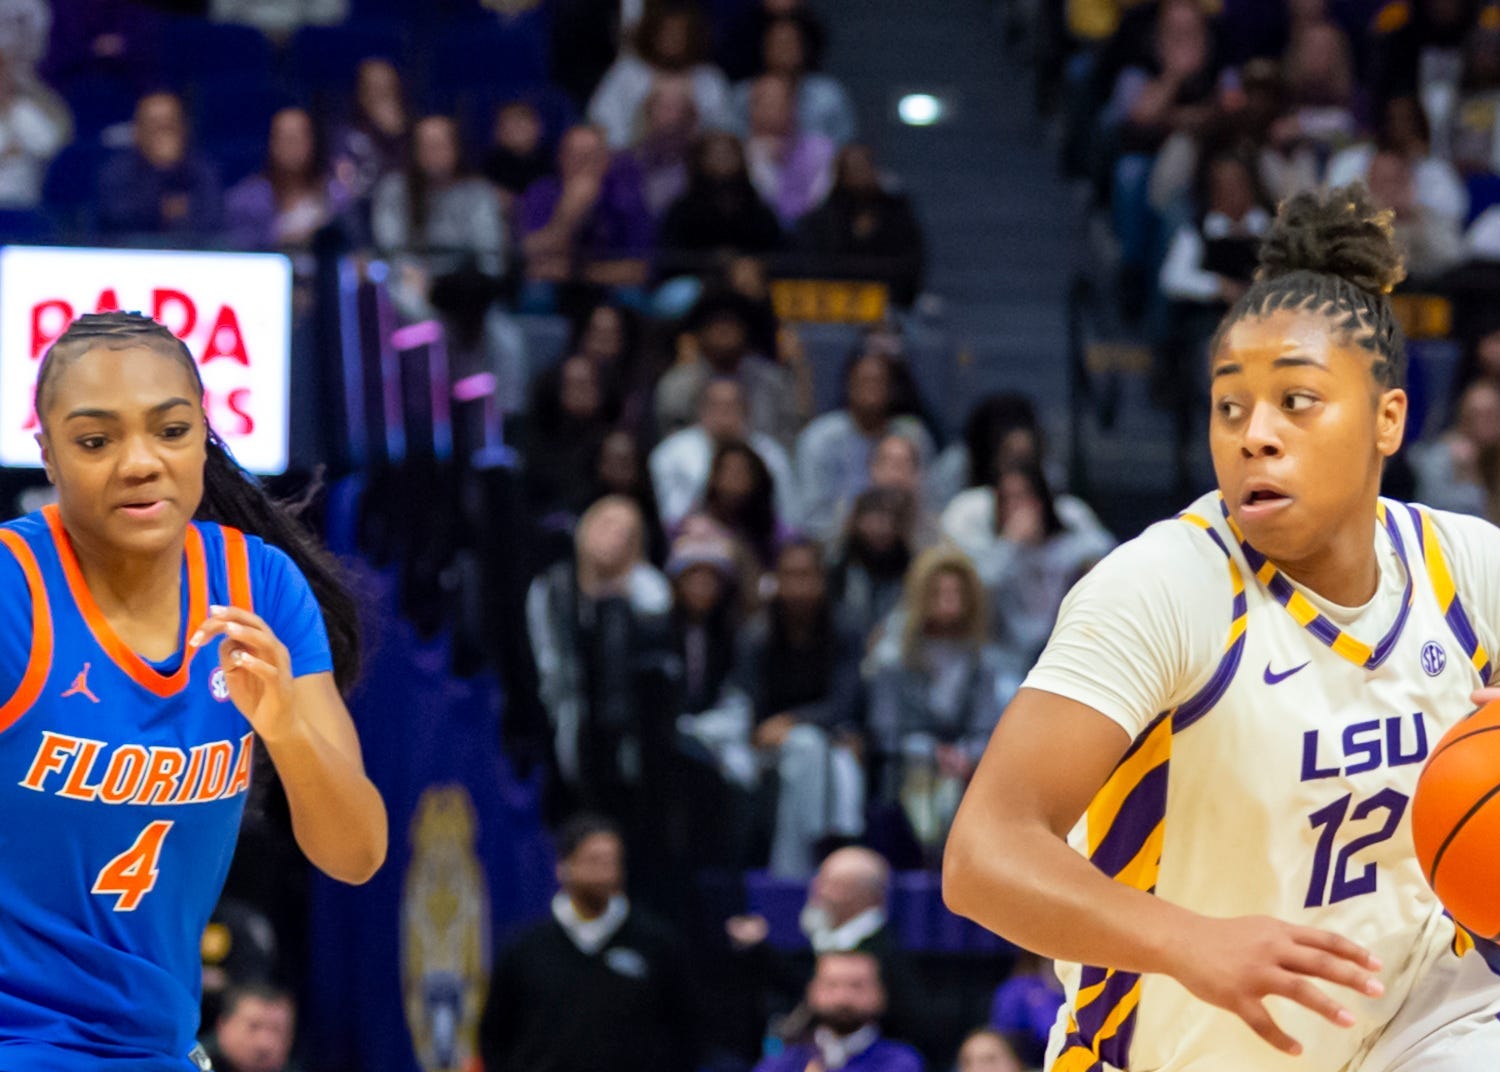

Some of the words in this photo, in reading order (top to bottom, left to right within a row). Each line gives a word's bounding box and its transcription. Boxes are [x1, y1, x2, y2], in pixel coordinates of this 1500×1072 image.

[1421, 642, 1446, 675] SEC
[18, 731, 254, 806] FLORIDA
[1300, 712, 1428, 782] LSU
[91, 820, 175, 912] 4
[1303, 787, 1410, 909] 12
